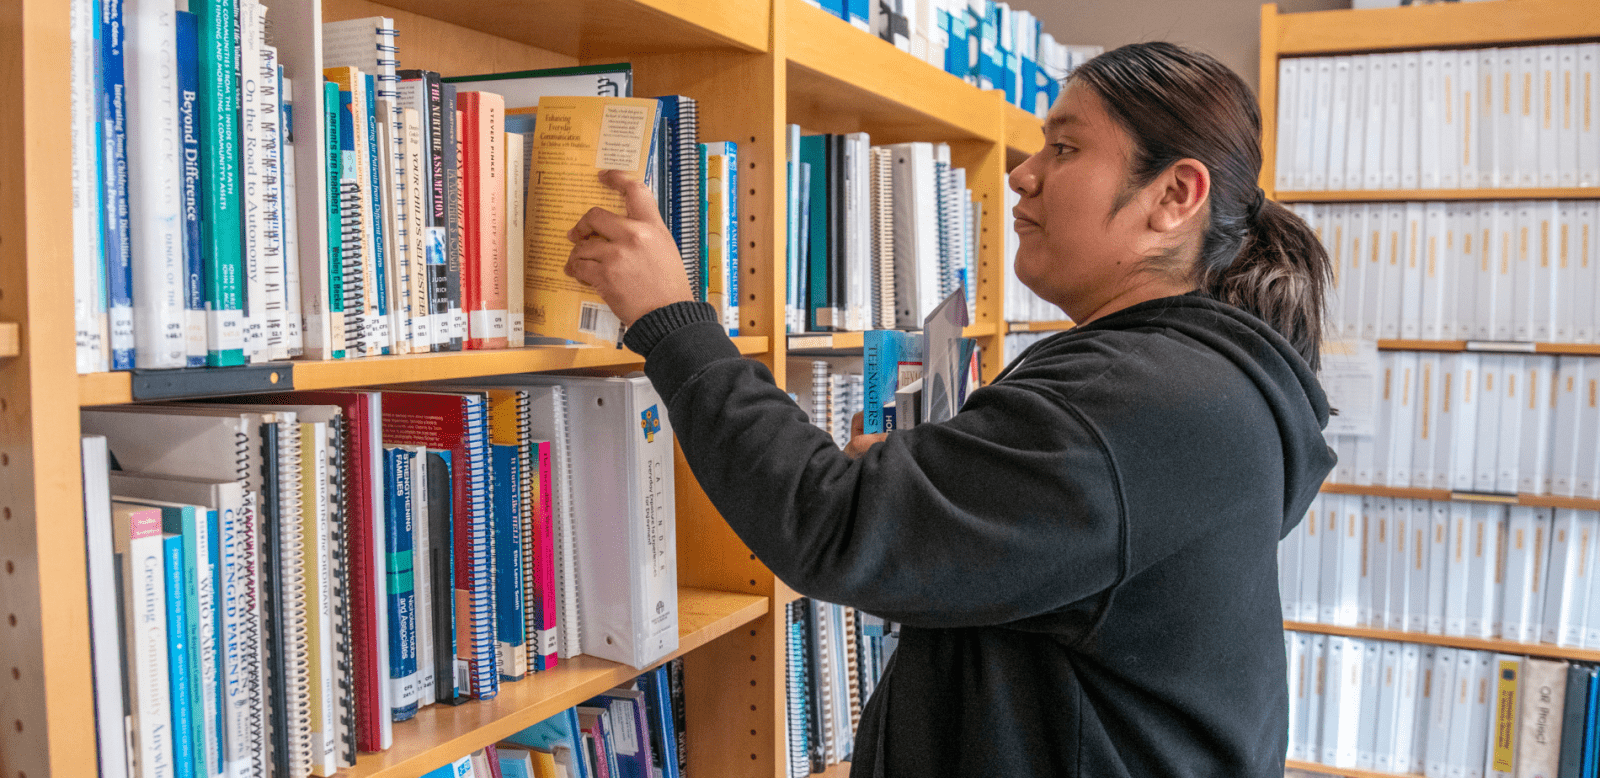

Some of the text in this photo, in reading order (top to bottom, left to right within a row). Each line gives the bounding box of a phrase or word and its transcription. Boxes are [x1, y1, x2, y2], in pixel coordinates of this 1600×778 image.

[222, 8, 230, 68] COMMUNITIES
[160, 38, 171, 107] SCOTT
[162, 115, 173, 164] PECK
[368, 115, 377, 140] Caring
[540, 133, 581, 141] Communication
[545, 114, 571, 123] Enhancing
[548, 124, 572, 132] Everyday
[180, 89, 199, 222] Beyond Difference
[218, 122, 226, 180] COMMUNITY'S
[329, 112, 339, 214] parents are teachers
[369, 143, 377, 153] for
[371, 154, 379, 183] Patients
[411, 153, 419, 184] YOUR
[431, 82, 444, 218] THE NURTURE ASSUMPTION
[105, 119, 116, 230] into Community Programs
[113, 83, 129, 267] Integrating Young Children with Disabilities
[219, 183, 227, 210] ASSETS
[245, 79, 258, 283] On the Road to Autonomy
[371, 184, 379, 205] from
[373, 207, 381, 236] Different
[413, 187, 422, 235] CHILD'S
[165, 233, 174, 268] DENIAL
[331, 246, 339, 274] Wesley
[166, 273, 175, 285] OF
[415, 239, 426, 317] SELF-ESTEEM
[868, 344, 878, 426] TEENAGERS
[885, 415, 893, 433] HOL
[319, 449, 327, 531] CELEBRATING
[396, 454, 404, 497] FAMILIES
[403, 453, 412, 532] STRENGTHENING
[648, 494, 656, 525] Exposure
[654, 462, 665, 571] CALENDAR
[200, 577, 210, 619] WHO
[224, 508, 239, 697] CHALLENGED PARENTS
[236, 507, 249, 694] SPECIAL CHILDREN,
[143, 555, 162, 715] Creating Community
[202, 623, 212, 683] CARES?
[400, 615, 409, 660] Associates
[1535, 707, 1549, 744] Project
